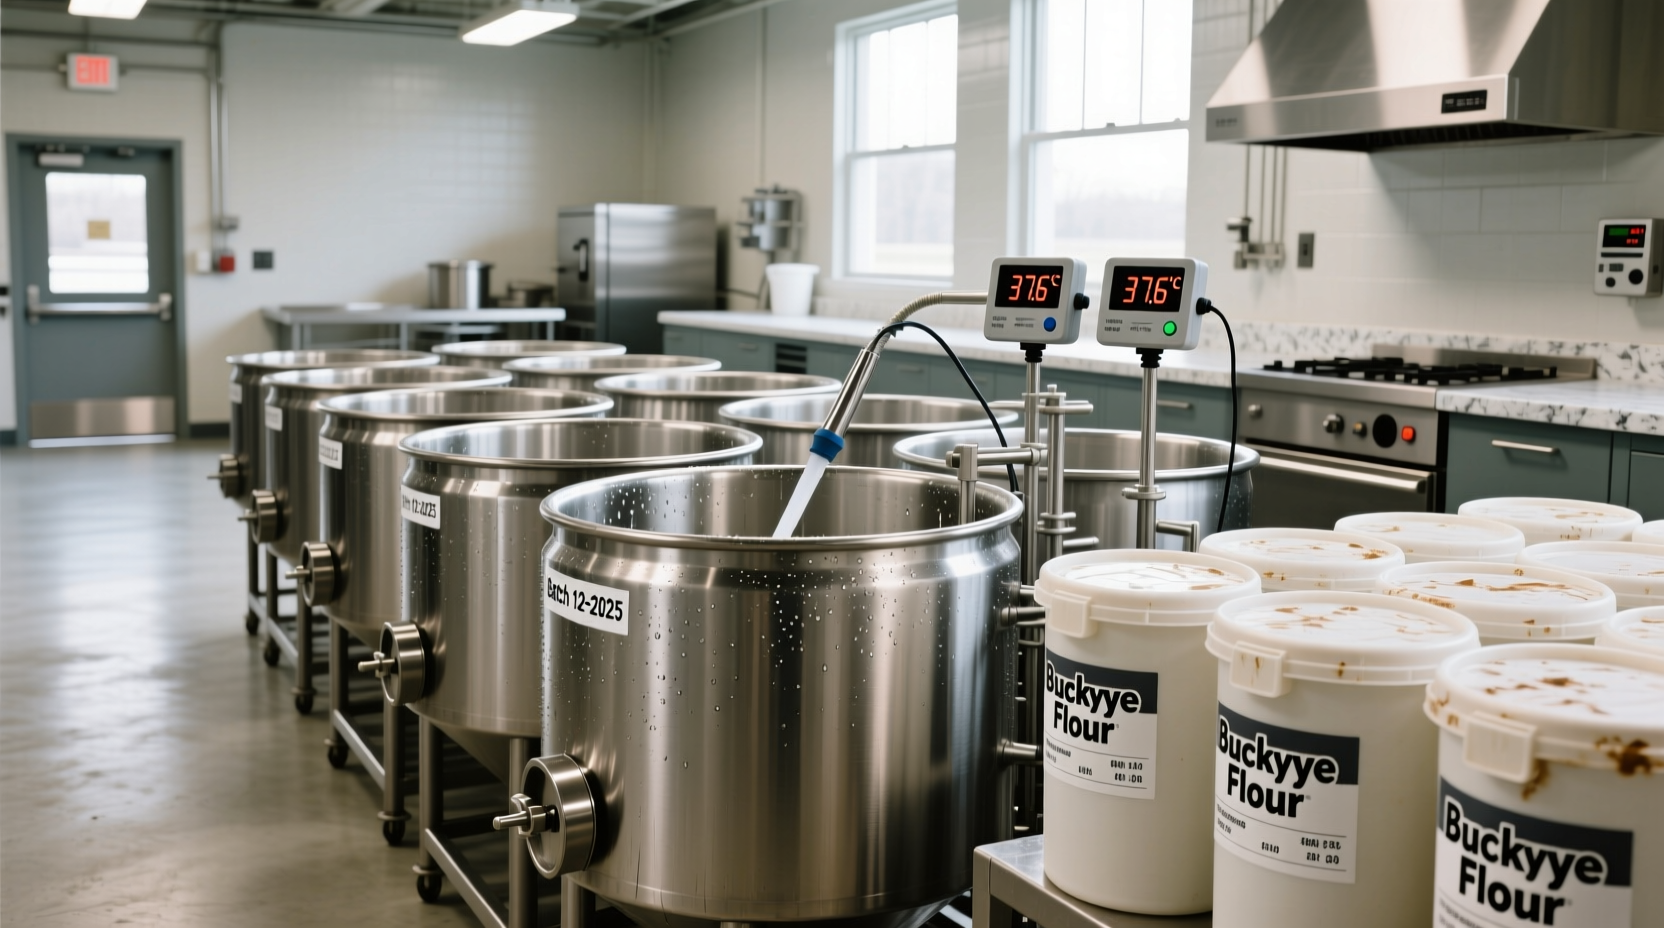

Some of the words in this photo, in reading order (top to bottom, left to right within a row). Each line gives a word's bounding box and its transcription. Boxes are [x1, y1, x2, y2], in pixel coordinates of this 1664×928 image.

[572, 589, 624, 622] 12-2025
[1046, 662, 1140, 719] Buckyye
[1053, 700, 1115, 745] Flour
[1220, 717, 1336, 790] Buckyye
[1227, 762, 1305, 818] Flour
[1445, 800, 1604, 891] Buckyye
[1459, 855, 1565, 926] Flour
